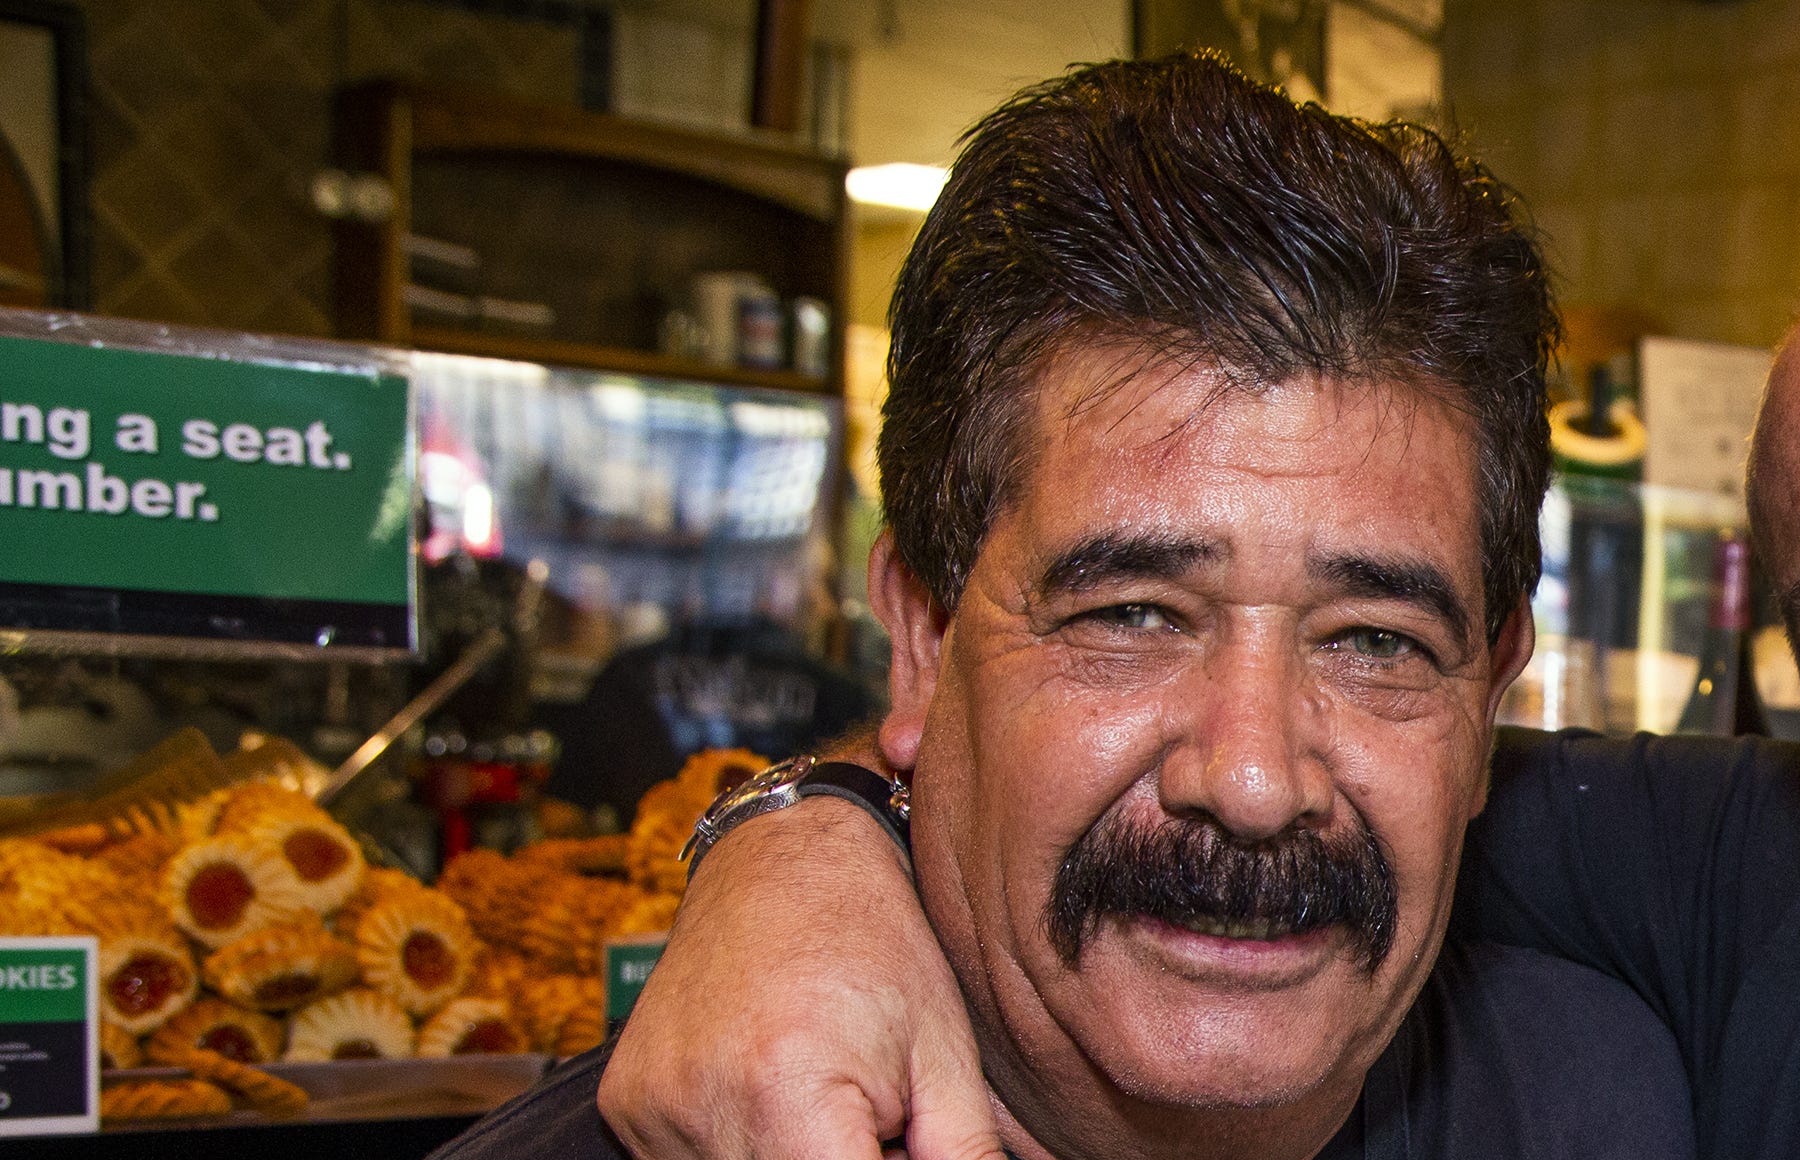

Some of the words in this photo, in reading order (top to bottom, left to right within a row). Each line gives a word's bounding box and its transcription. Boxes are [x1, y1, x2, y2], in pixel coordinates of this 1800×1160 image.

[115, 413, 160, 454] a
[182, 418, 352, 471] seat.
[0, 965, 78, 990] KIES
